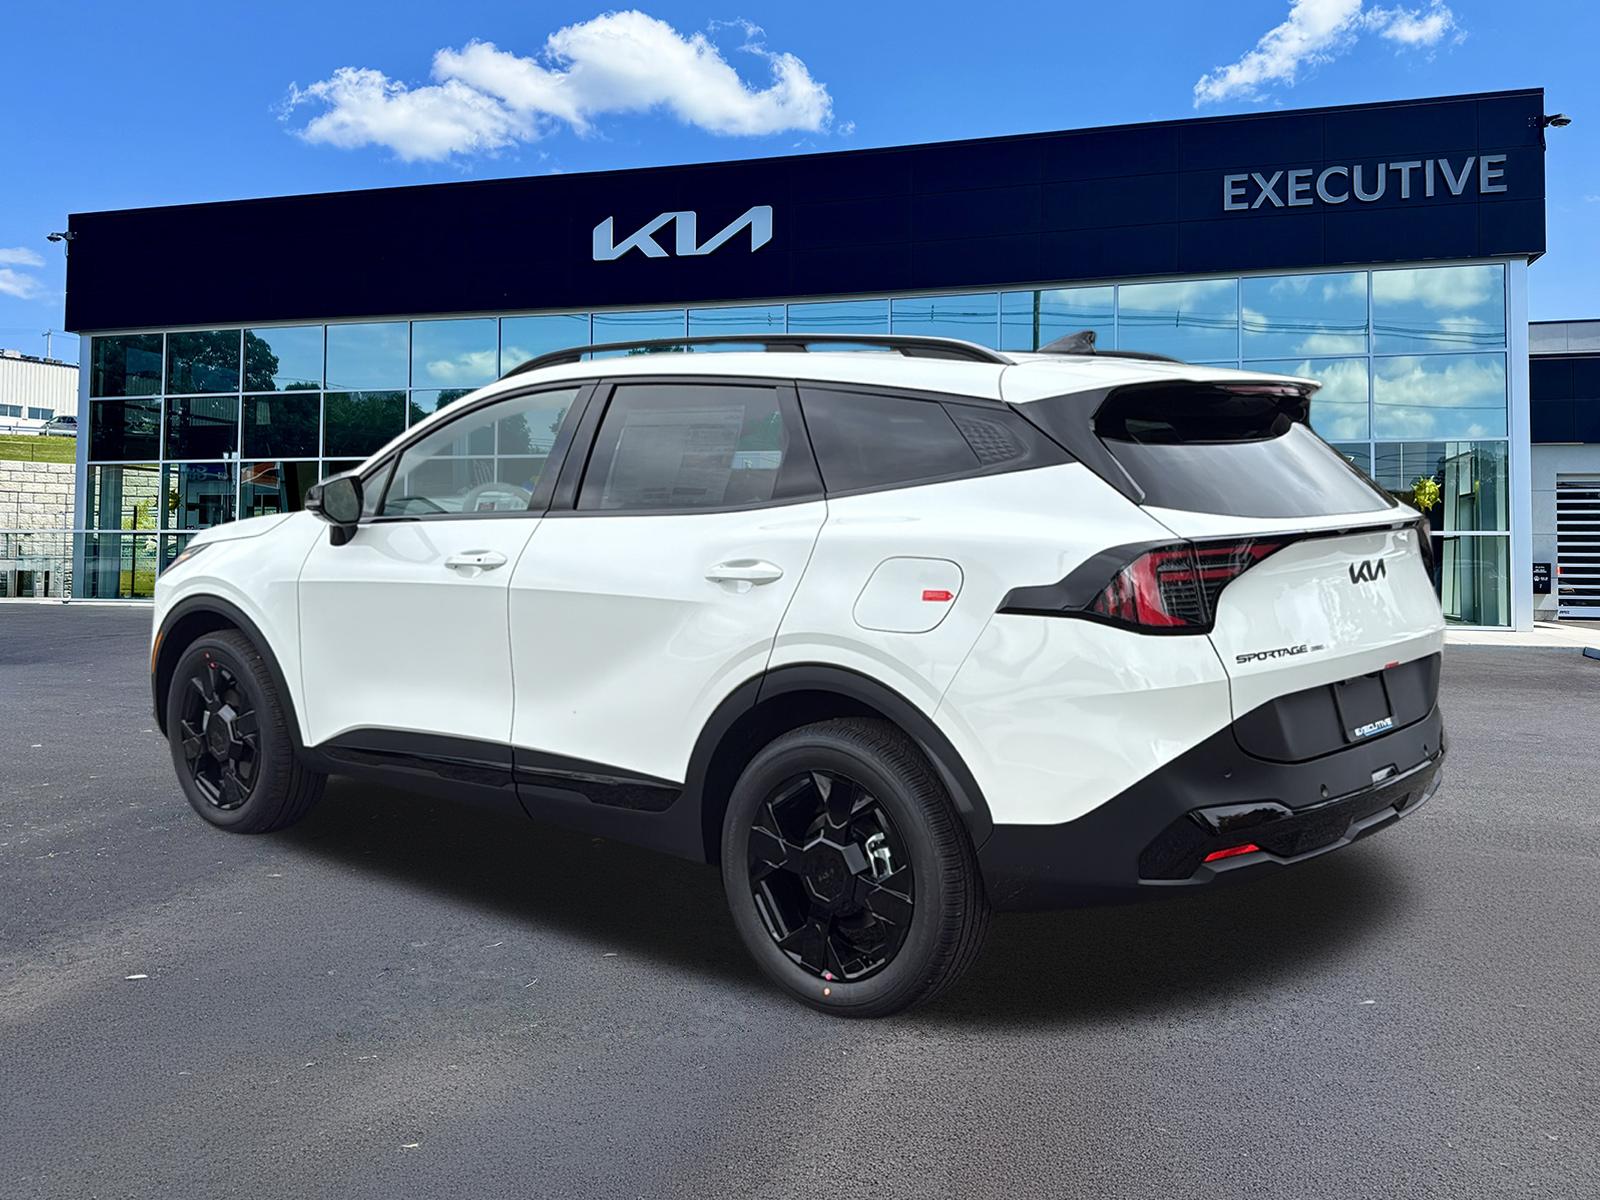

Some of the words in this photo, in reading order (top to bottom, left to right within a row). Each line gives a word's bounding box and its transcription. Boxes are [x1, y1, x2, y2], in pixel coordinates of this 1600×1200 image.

[1223, 154, 1508, 211] EXECUTIVE
[592, 205, 773, 262] KIA
[1348, 557, 1387, 584] KIA
[1235, 644, 1309, 664] SPORTAGE
